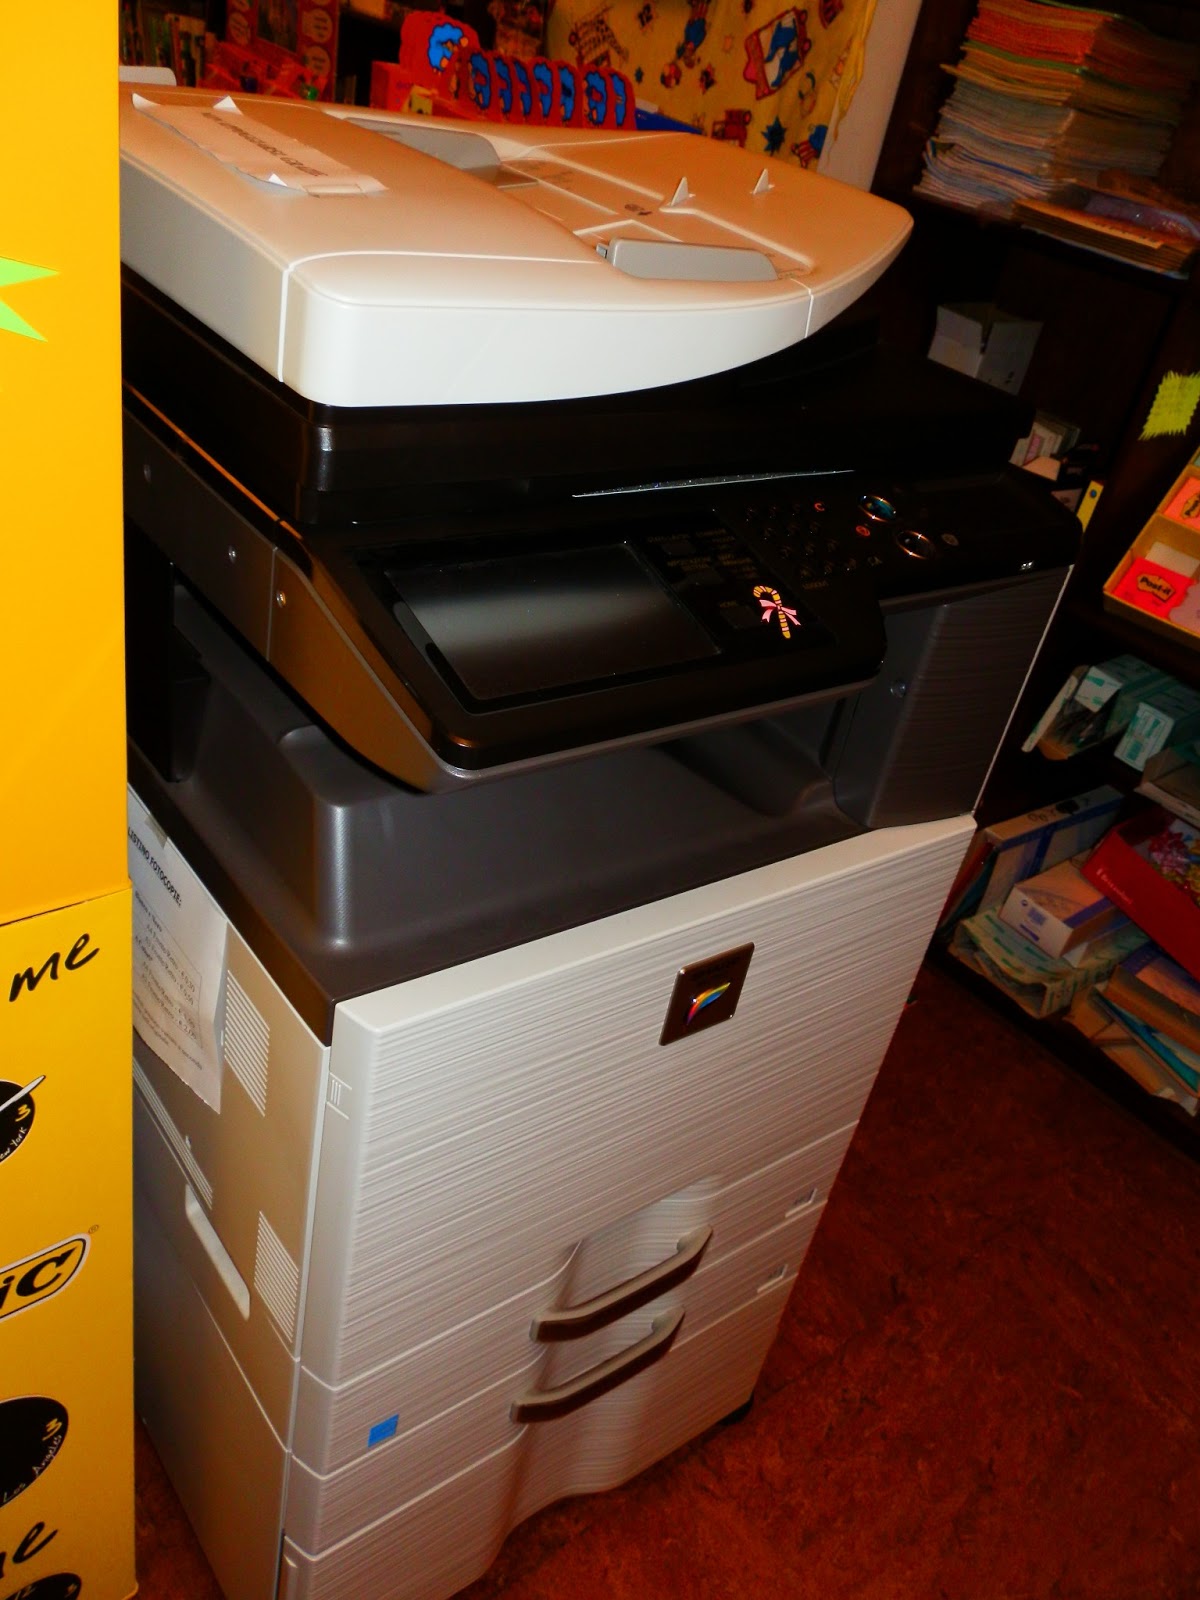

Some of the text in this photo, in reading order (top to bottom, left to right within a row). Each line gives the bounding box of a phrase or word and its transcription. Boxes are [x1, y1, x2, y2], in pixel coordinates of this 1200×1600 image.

[1140, 576, 1172, 596] Post-it
[150, 857, 182, 908] FOTOCOPIE:
[15, 1104, 31, 1122] 3
[10, 1126, 28, 1148] York
[41, 1417, 63, 1442] 3
